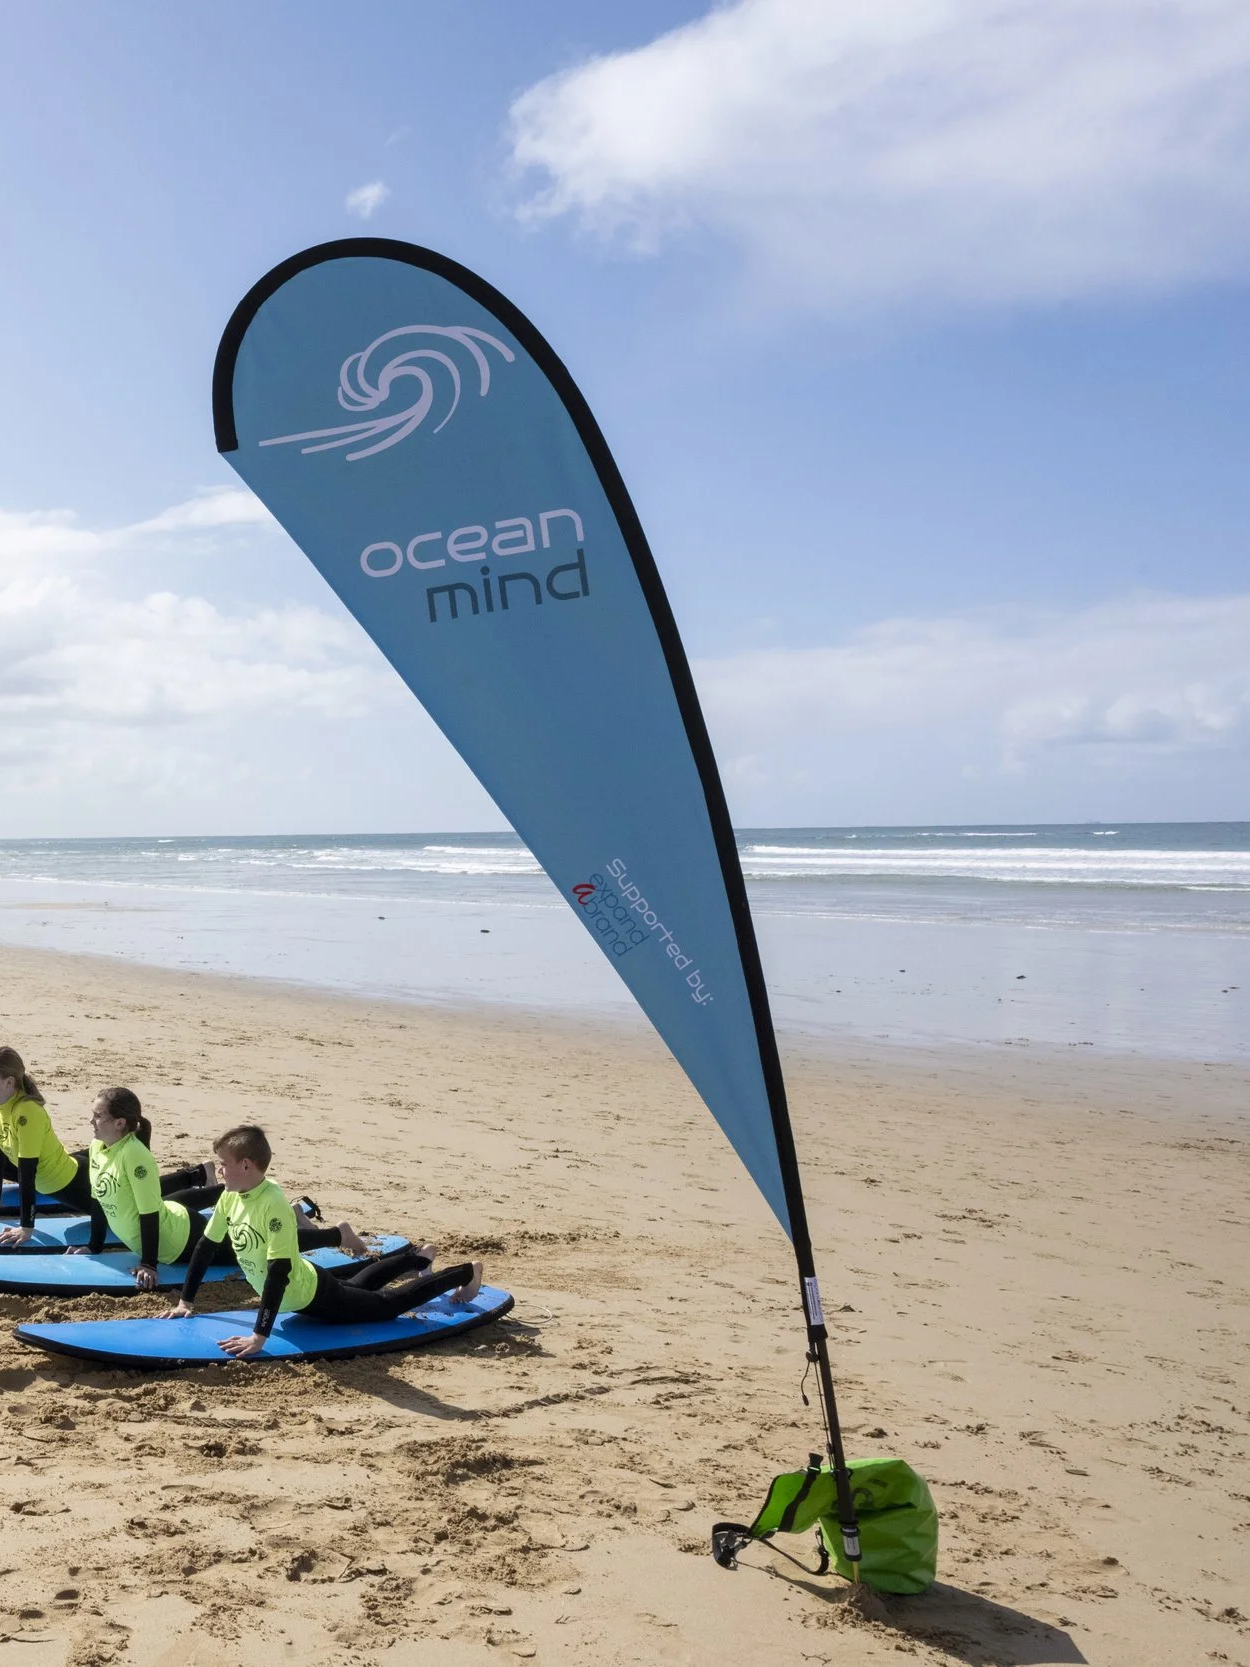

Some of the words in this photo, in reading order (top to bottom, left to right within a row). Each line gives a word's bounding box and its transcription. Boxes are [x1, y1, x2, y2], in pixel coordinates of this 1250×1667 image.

[360, 508, 584, 577] ocean
[426, 548, 590, 622] mind
[589, 873, 650, 946] expand
[606, 858, 693, 970] Supported
[686, 969, 713, 1006] by:
